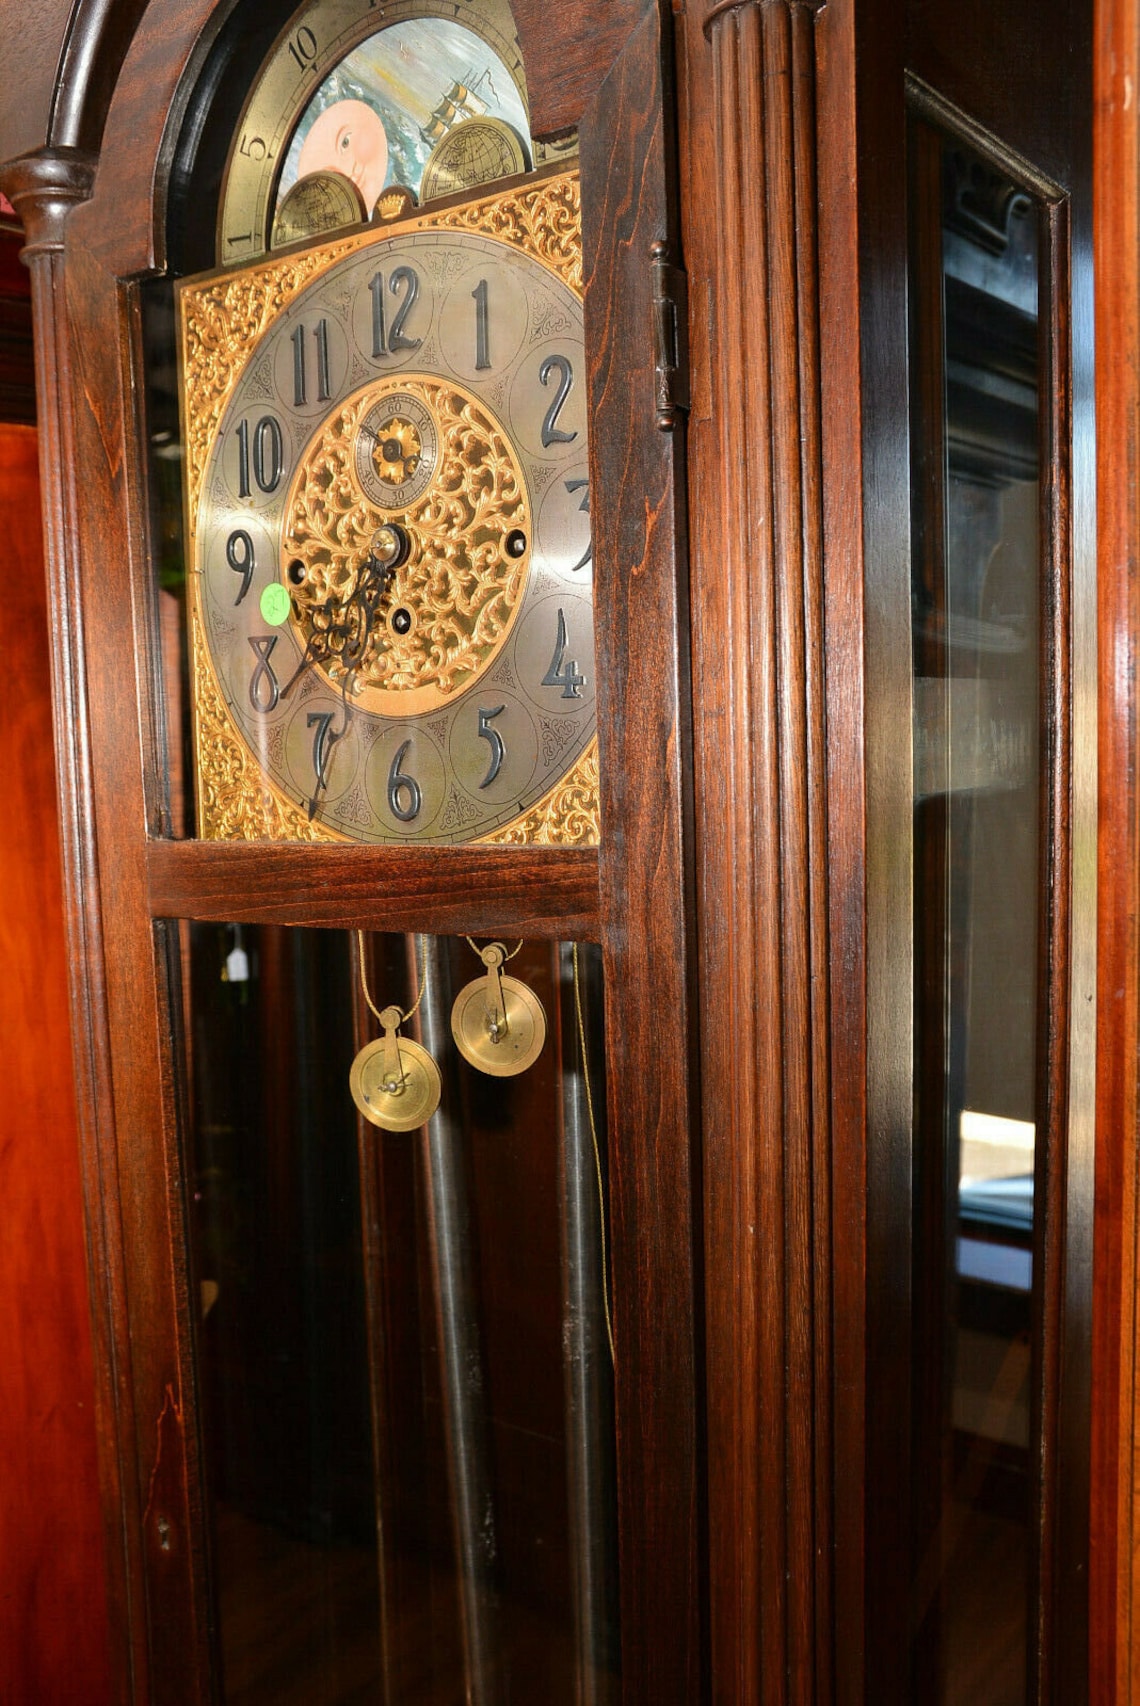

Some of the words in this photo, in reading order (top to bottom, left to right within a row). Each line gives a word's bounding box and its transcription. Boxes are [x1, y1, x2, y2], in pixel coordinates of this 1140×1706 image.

[288, 26, 318, 73] 10
[240, 134, 266, 161] 5
[227, 231, 252, 247] 1
[368, 266, 423, 358] 12
[472, 279, 492, 371] 1
[290, 319, 331, 406] 11
[539, 354, 578, 448] 2
[388, 403, 401, 414] 60
[418, 415, 429, 432] 10
[235, 415, 283, 498] 10
[365, 470, 375, 486] 40
[392, 490, 405, 501] 30
[226, 529, 255, 606] 9
[247, 635, 280, 714] 8
[541, 608, 588, 699] 4
[307, 712, 334, 790] 7
[387, 738, 422, 822] 6
[478, 704, 507, 789] 5
